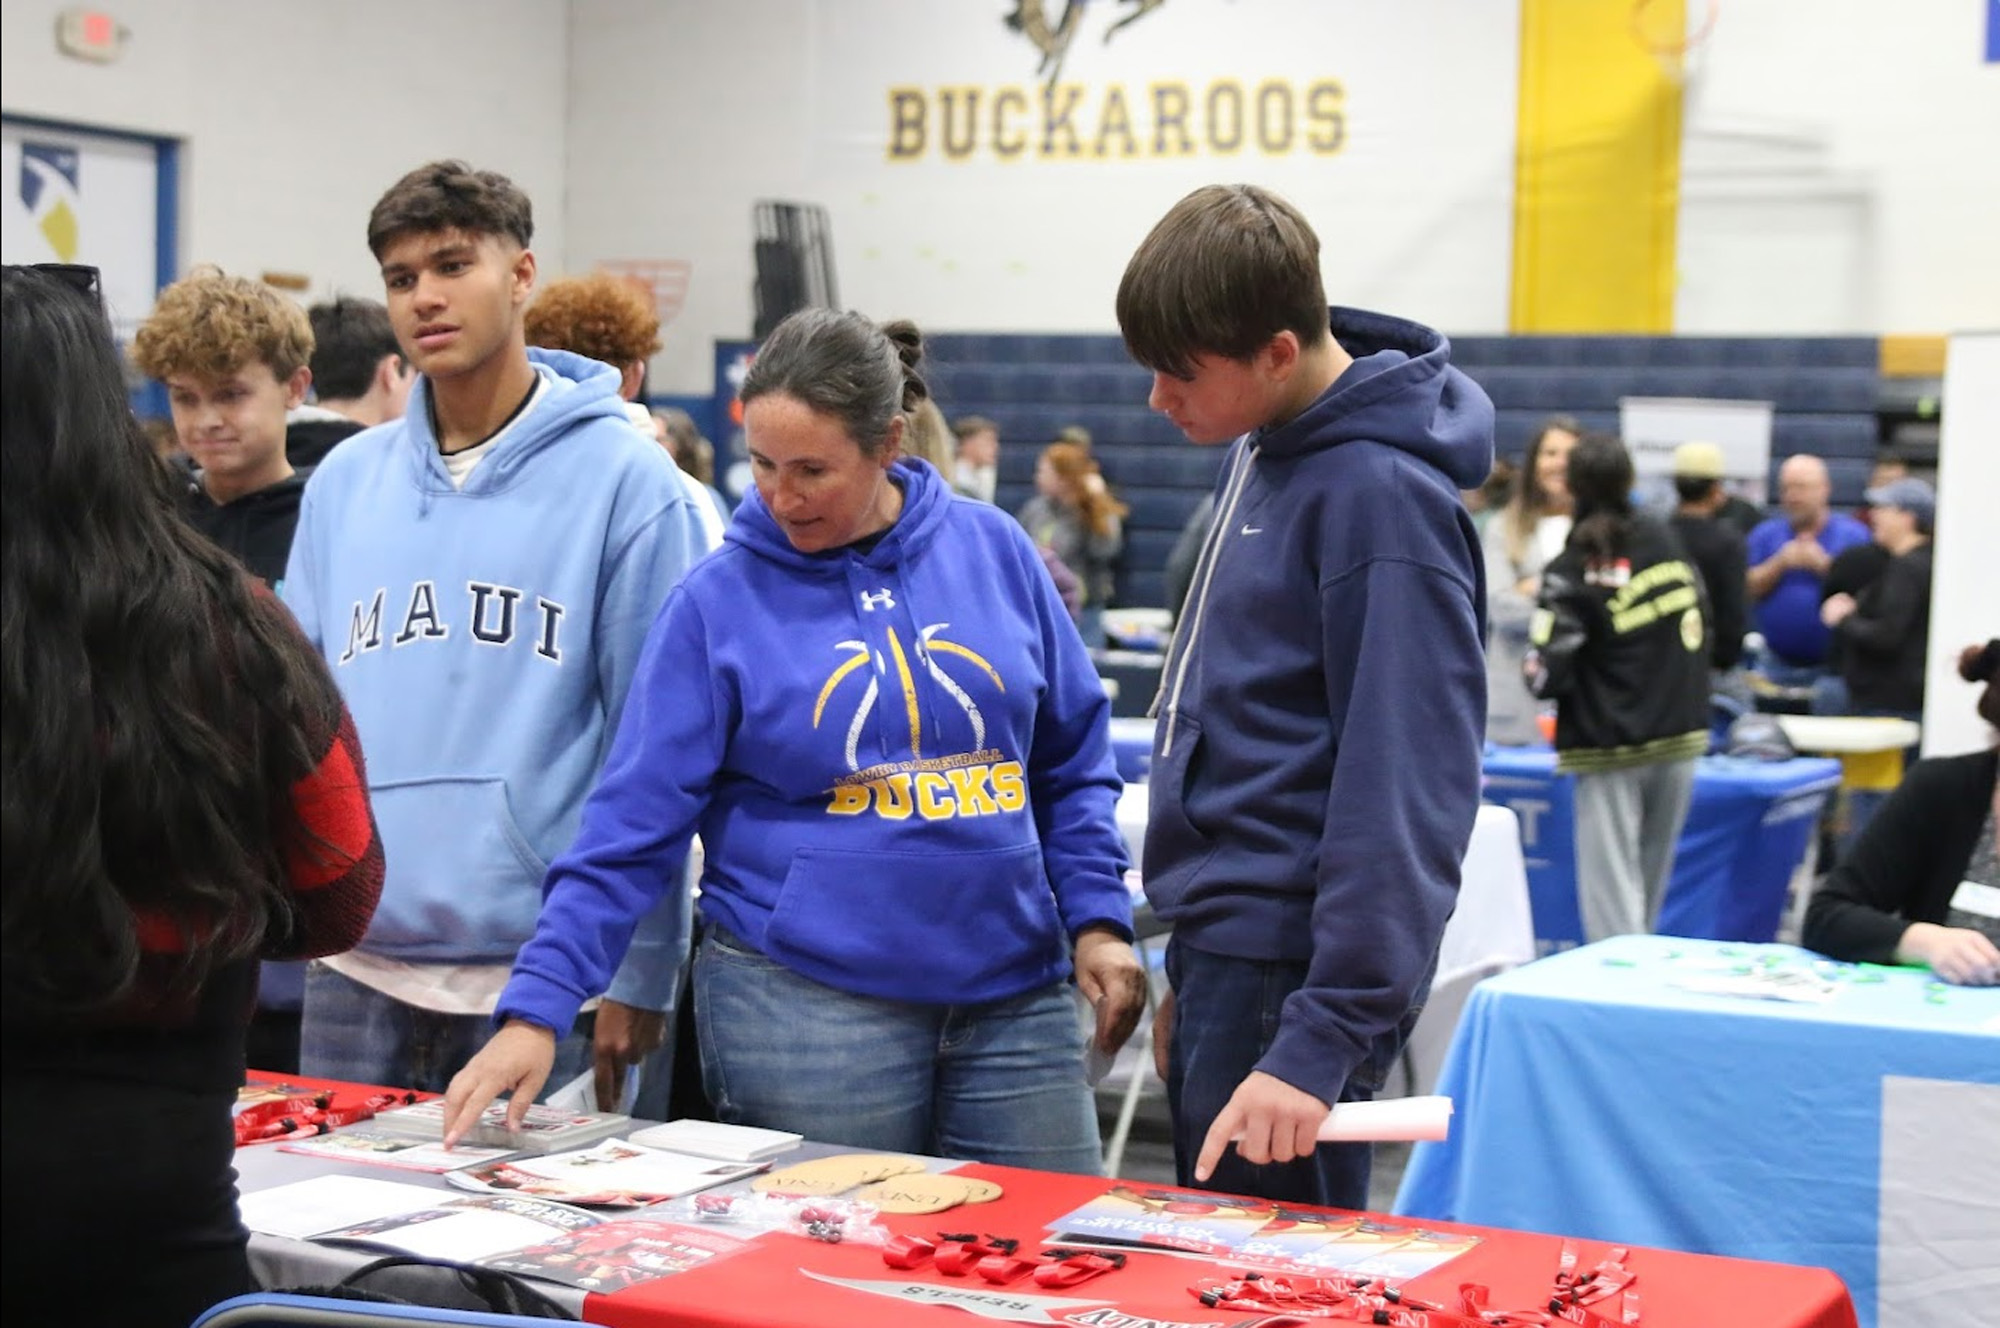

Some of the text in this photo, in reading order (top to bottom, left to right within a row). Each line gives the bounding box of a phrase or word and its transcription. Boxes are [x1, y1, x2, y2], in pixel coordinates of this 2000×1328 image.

[887, 80, 1347, 163] BUCKAROOS
[338, 580, 565, 665] MAUI
[826, 760, 1026, 821] BUCKS
[834, 748, 1004, 787] LOWRY BASKETBALL
[902, 1286, 1031, 1311] REBELS
